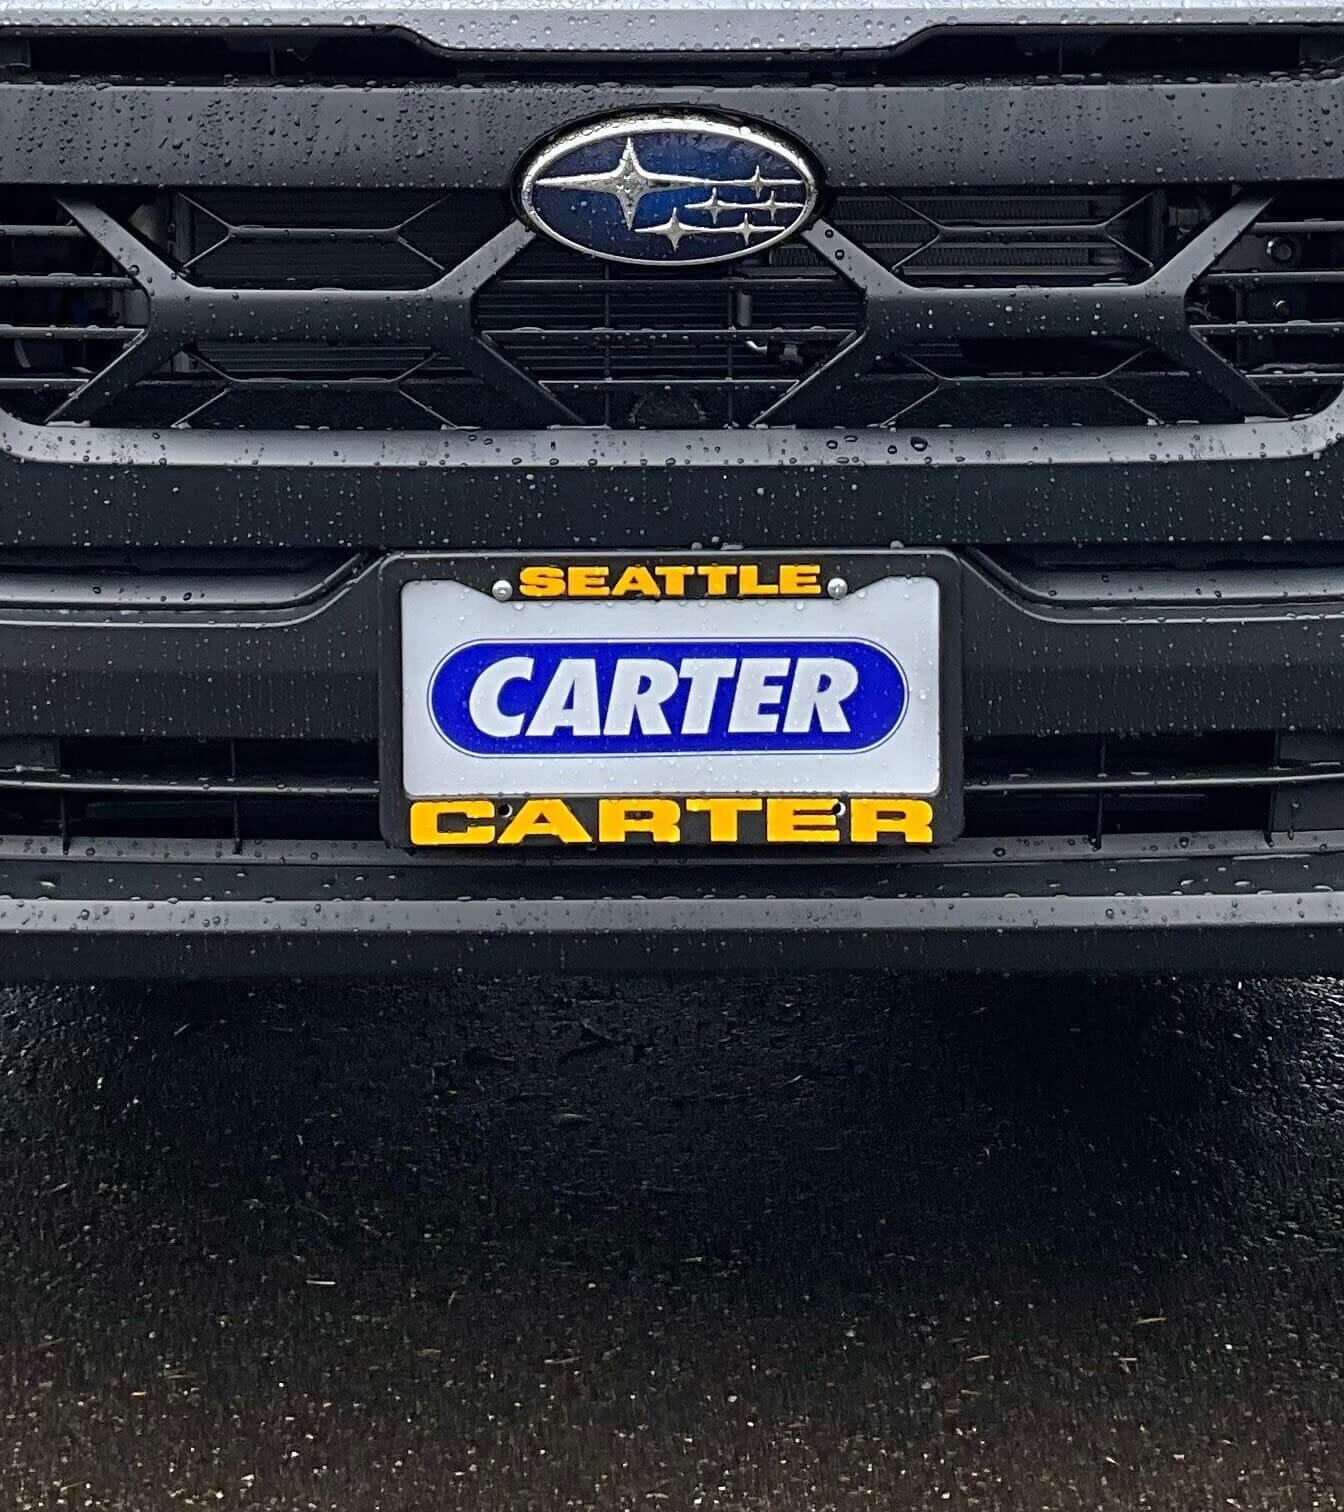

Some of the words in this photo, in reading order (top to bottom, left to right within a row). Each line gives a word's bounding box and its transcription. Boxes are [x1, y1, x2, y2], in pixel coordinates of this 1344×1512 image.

[519, 565, 821, 596] SEATTLE
[468, 656, 858, 737] CARTER
[409, 798, 934, 846] CARTER
